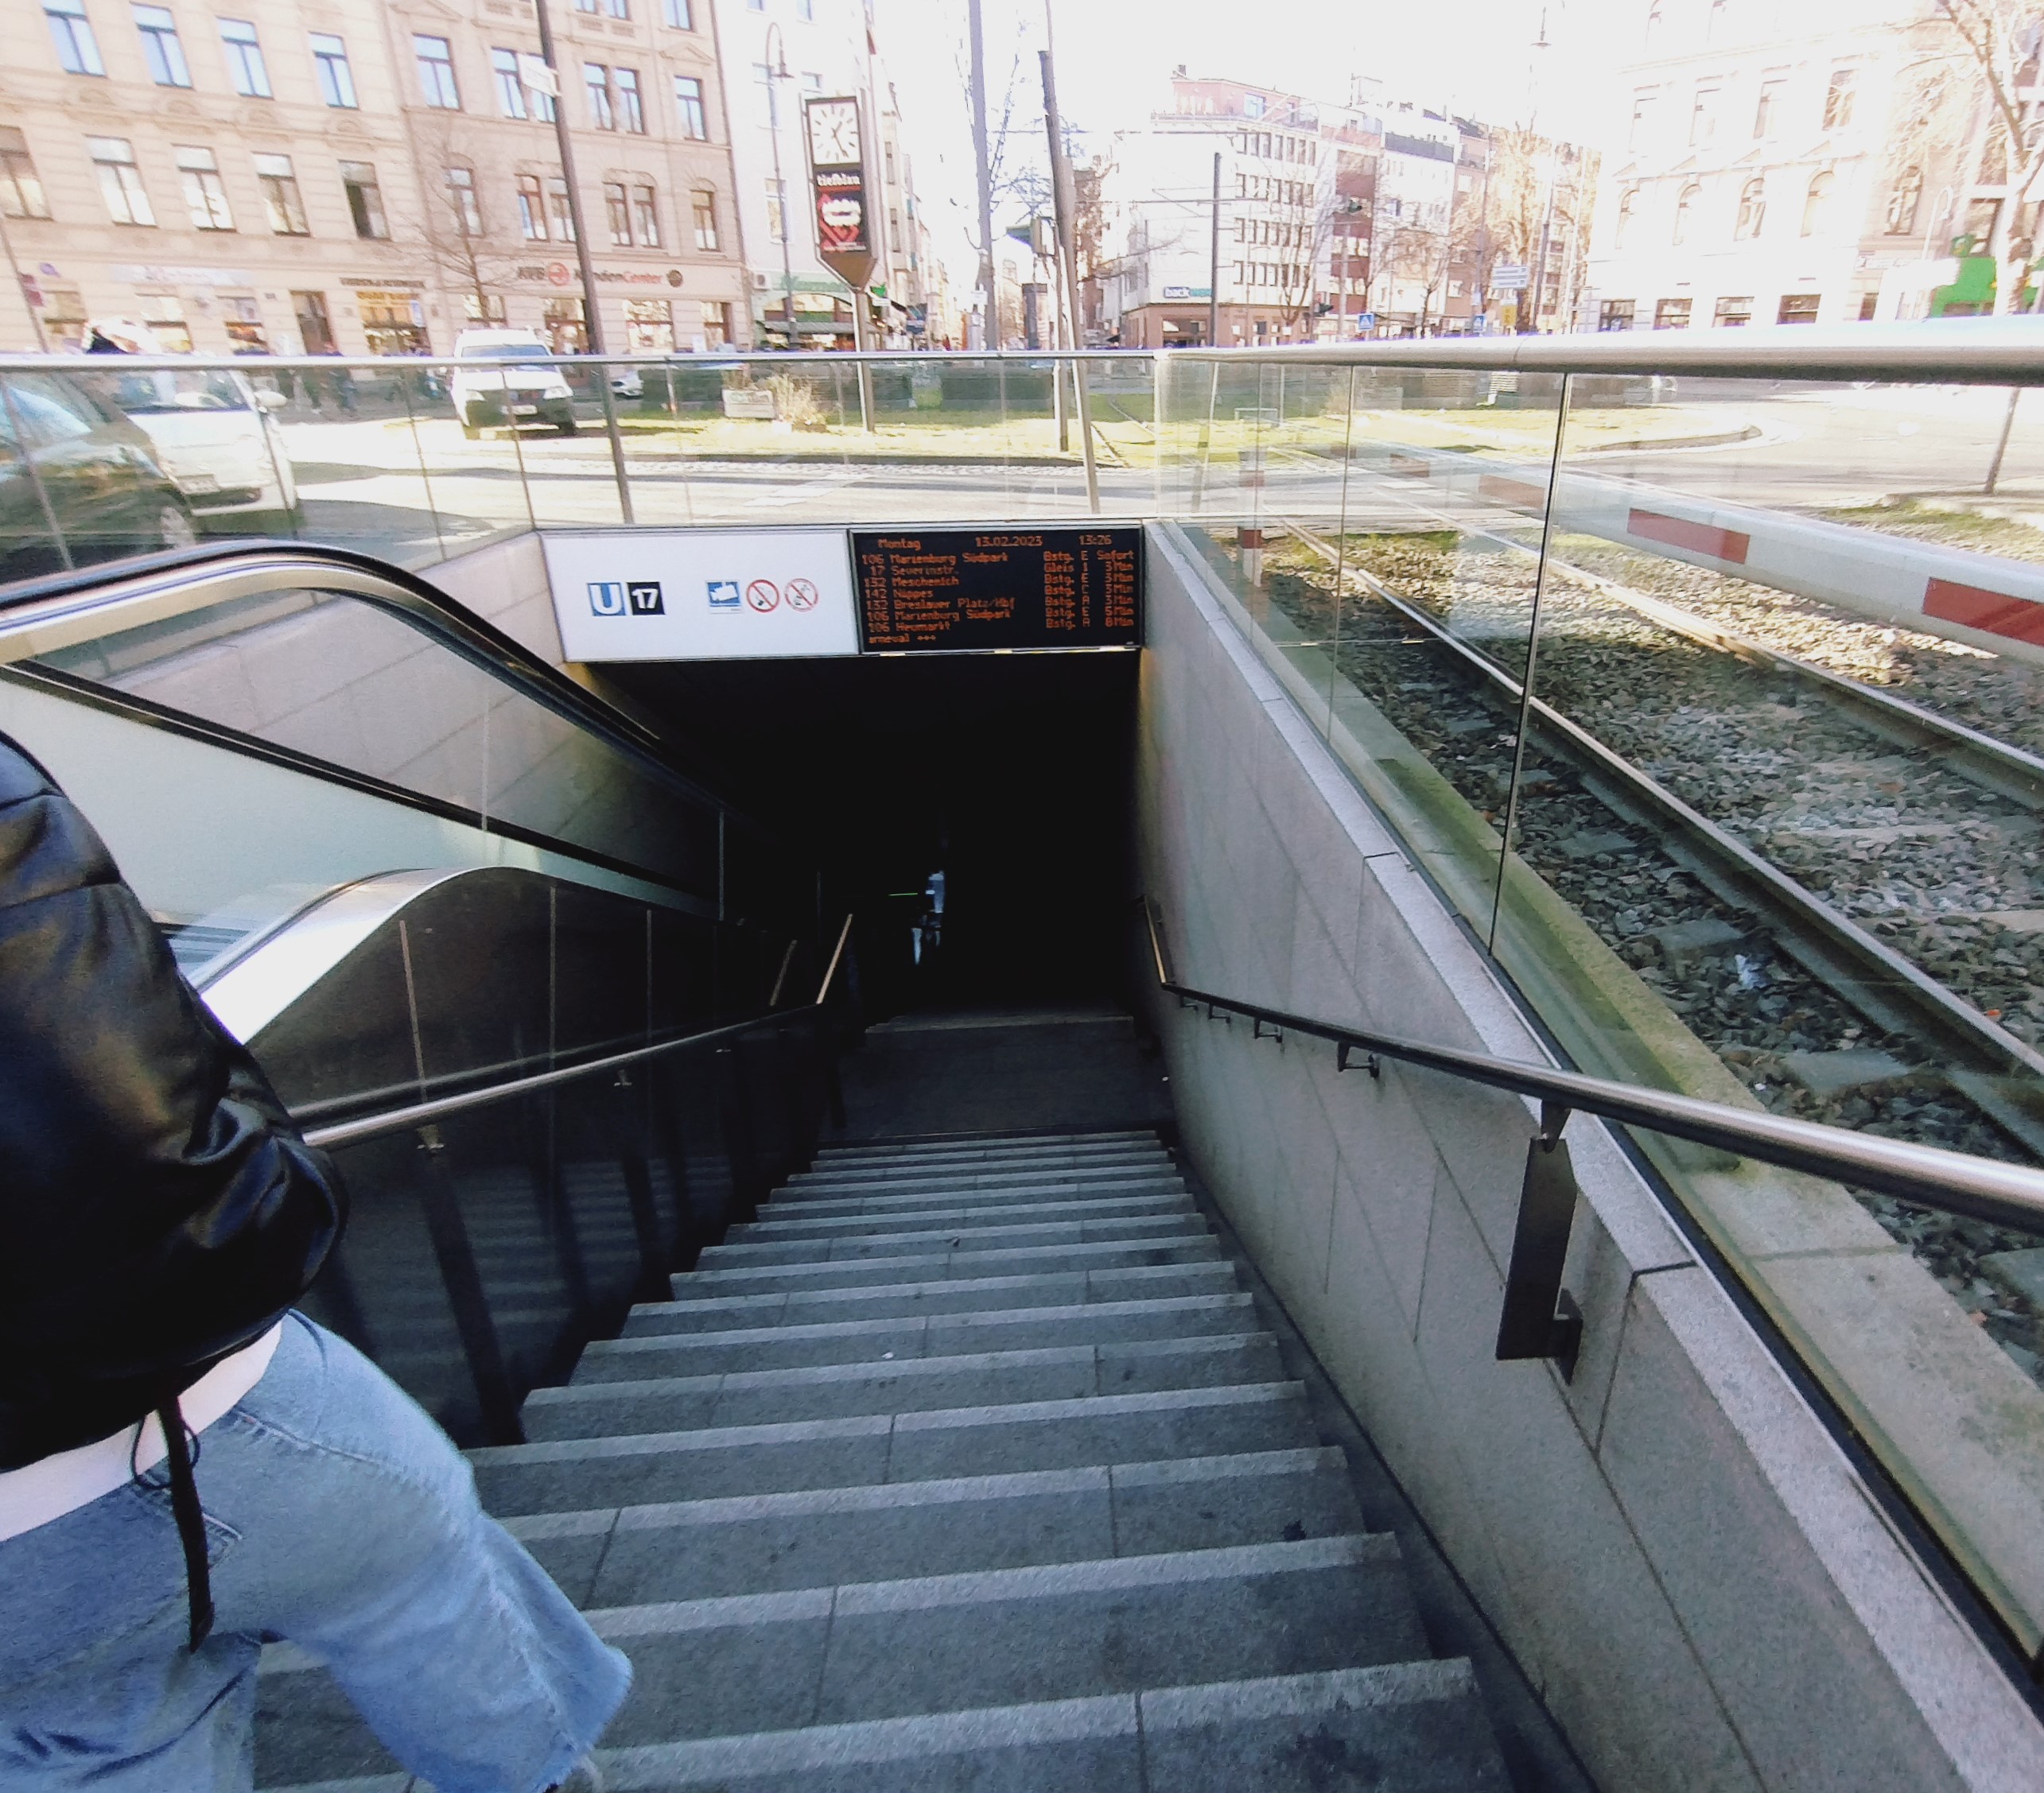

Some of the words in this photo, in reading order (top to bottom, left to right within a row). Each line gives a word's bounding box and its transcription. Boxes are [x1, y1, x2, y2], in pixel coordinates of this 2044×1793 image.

[877, 538, 921, 550] Montag
[975, 535, 1043, 547] 13.02.2023
[1078, 534, 1112, 545] 13:26
[889, 553, 957, 565] Marienburg
[1043, 550, 1074, 562] Bstg.
[1081, 550, 1088, 560] E
[1097, 549, 1133, 561] Sofort
[871, 565, 885, 575] 17
[891, 565, 958, 575] Severinstr.
[1044, 562, 1074, 572] Gleis
[892, 576, 960, 586] Meschenich
[1044, 573, 1074, 584] Bstg.
[1081, 572, 1089, 582] E
[589, 584, 622, 615] U
[631, 588, 659, 609] 17
[893, 588, 933, 600] Nippes
[1044, 584, 1074, 596] Bstg.
[894, 599, 950, 609] Breslauer
[1044, 596, 1075, 607] Bstg.
[1082, 595, 1090, 605] A
[895, 609, 960, 622] Marienburg
[1045, 607, 1075, 619] Bstg.
[1082, 606, 1090, 616] E
[896, 620, 950, 631] Heumarkt
[1046, 618, 1075, 630] Bstg.
